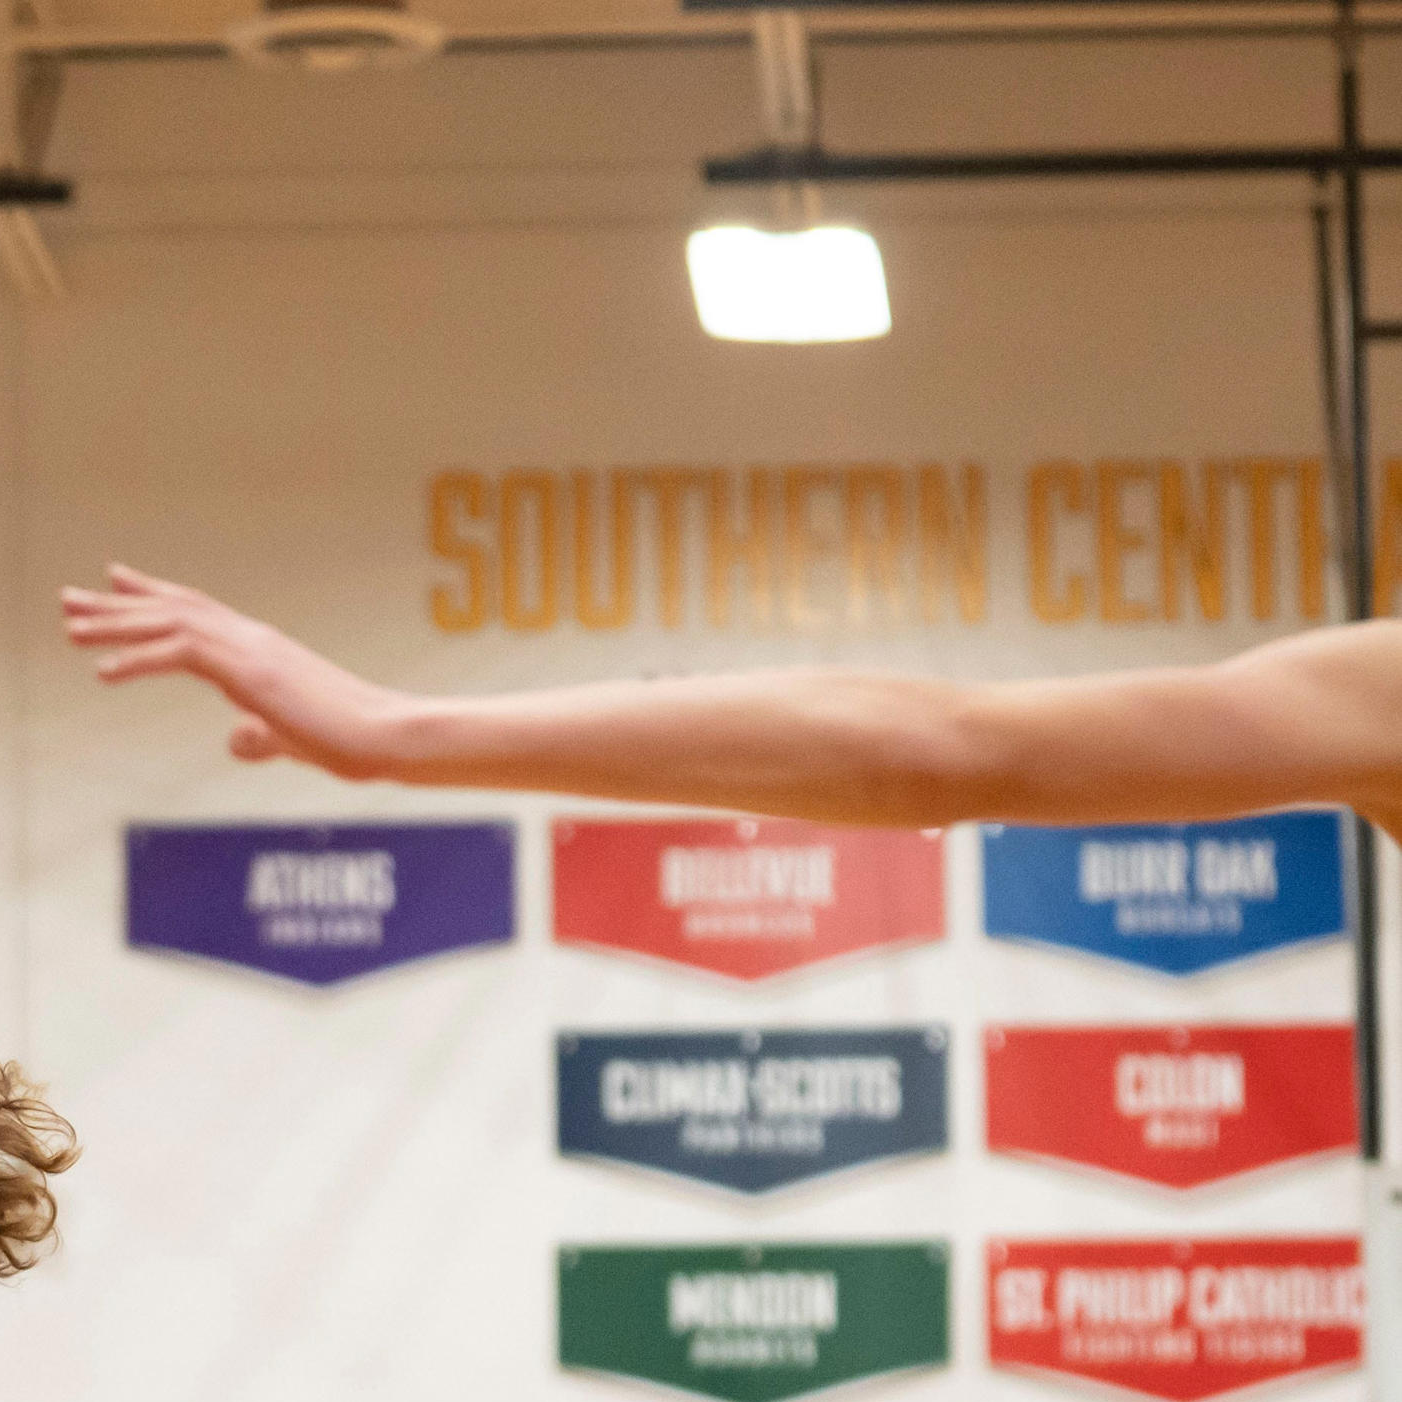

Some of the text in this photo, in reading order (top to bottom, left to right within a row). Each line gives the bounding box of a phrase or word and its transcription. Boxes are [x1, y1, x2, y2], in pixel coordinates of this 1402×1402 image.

[428, 463, 988, 634] SOUTHERN
[246, 849, 396, 914] ATHENS
[1115, 1052, 1246, 1116] COLON
